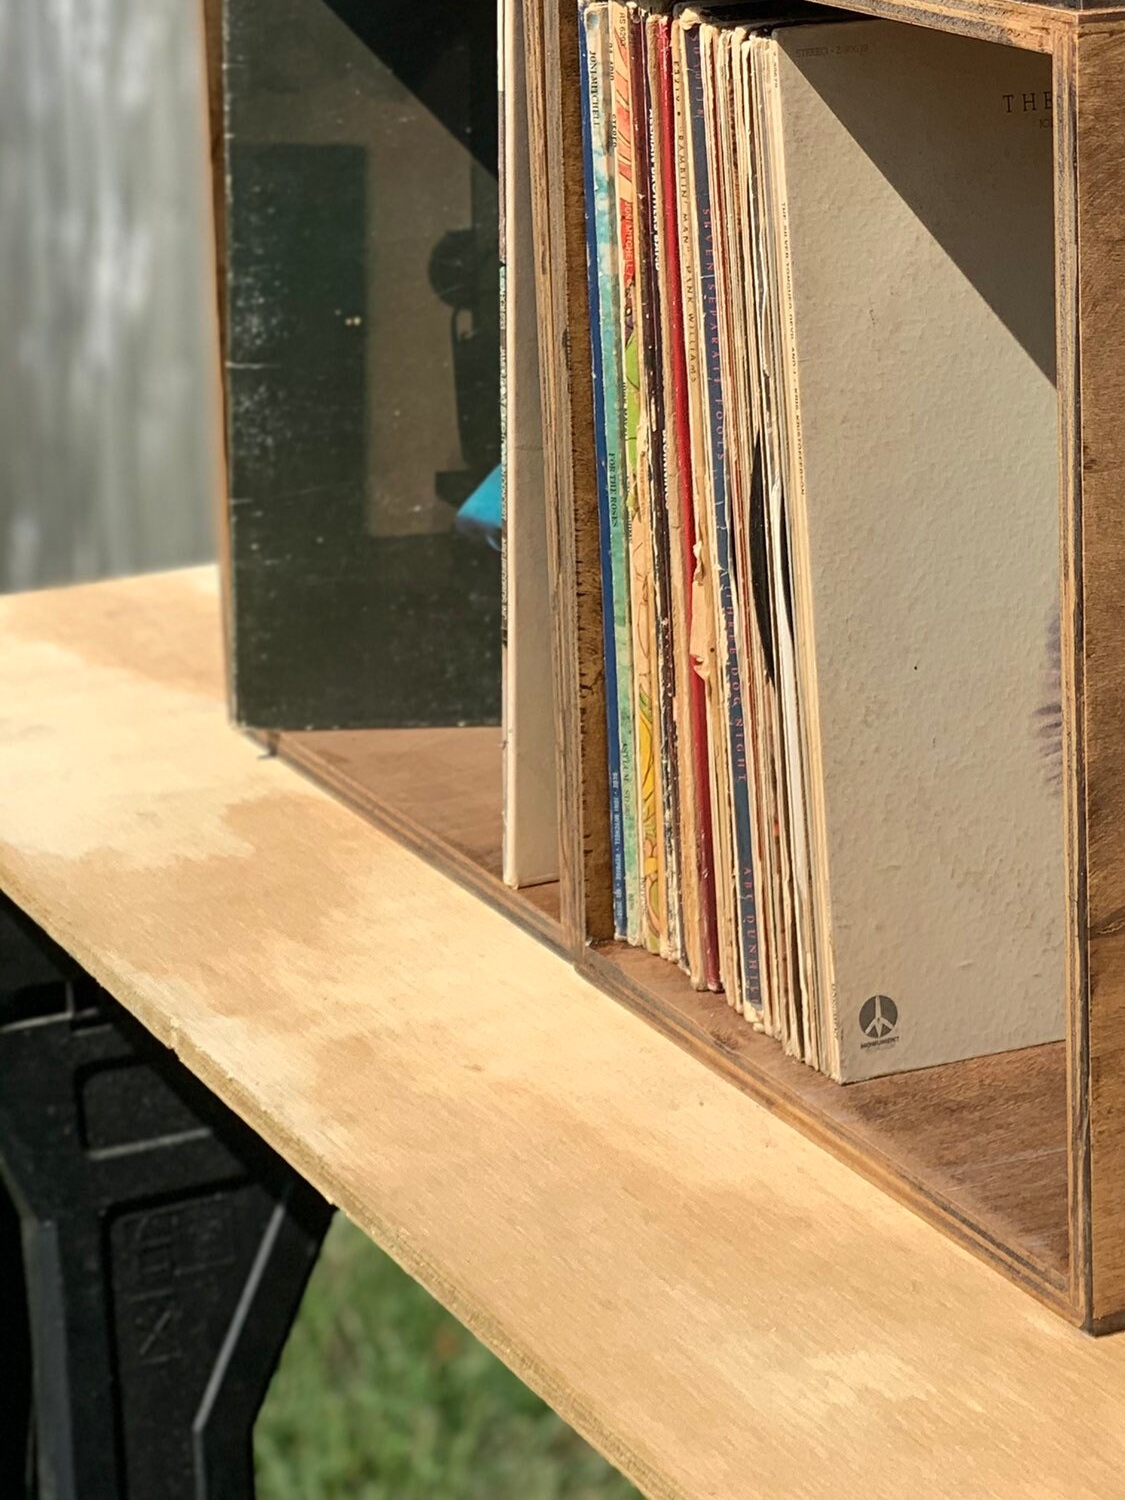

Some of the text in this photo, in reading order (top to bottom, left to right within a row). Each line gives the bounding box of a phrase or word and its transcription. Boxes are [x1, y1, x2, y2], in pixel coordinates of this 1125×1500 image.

[588, 50, 600, 128] JONI MITCHELL
[623, 202, 632, 223] JONI
[702, 209, 714, 271] SEVEN
[625, 225, 634, 269] MITCHELL
[687, 313, 698, 383] WILLIAMS
[707, 283, 722, 384] SEPARATE
[607, 453, 619, 528] FOR THE ROSES
[725, 592, 747, 781] THREE DOG NIGHT
[613, 814, 621, 845] MITCHELL
[743, 868, 754, 901] ABC
